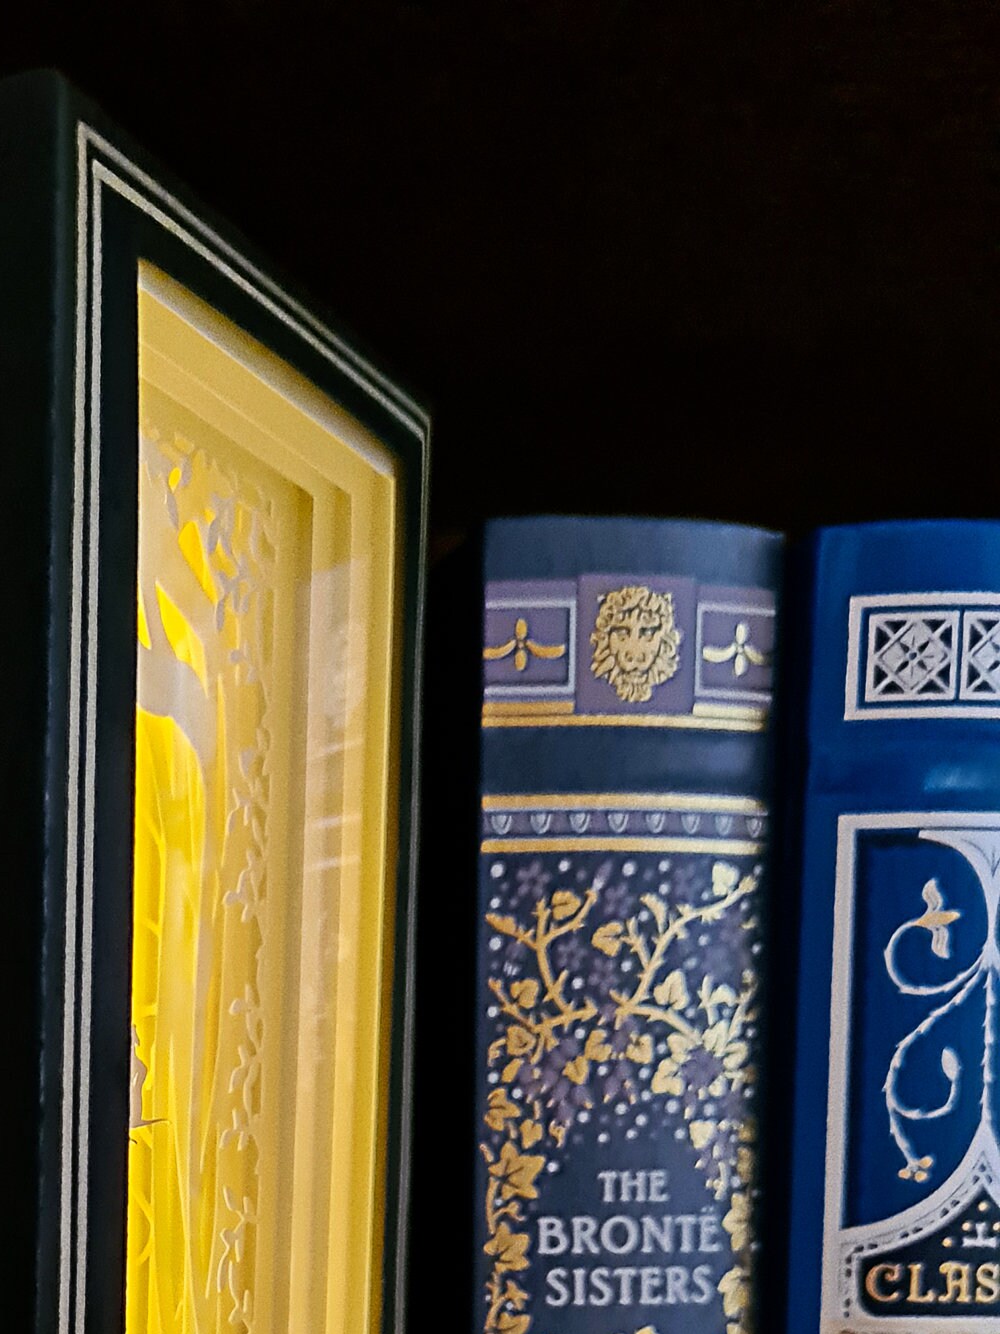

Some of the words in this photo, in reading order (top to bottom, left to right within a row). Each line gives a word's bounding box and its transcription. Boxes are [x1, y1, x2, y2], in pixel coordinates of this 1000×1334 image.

[597, 1169, 671, 1203] THE
[536, 1205, 724, 1256] BRONTË
[544, 1263, 716, 1307] SISTERS
[865, 1261, 1000, 1303] CLAS
